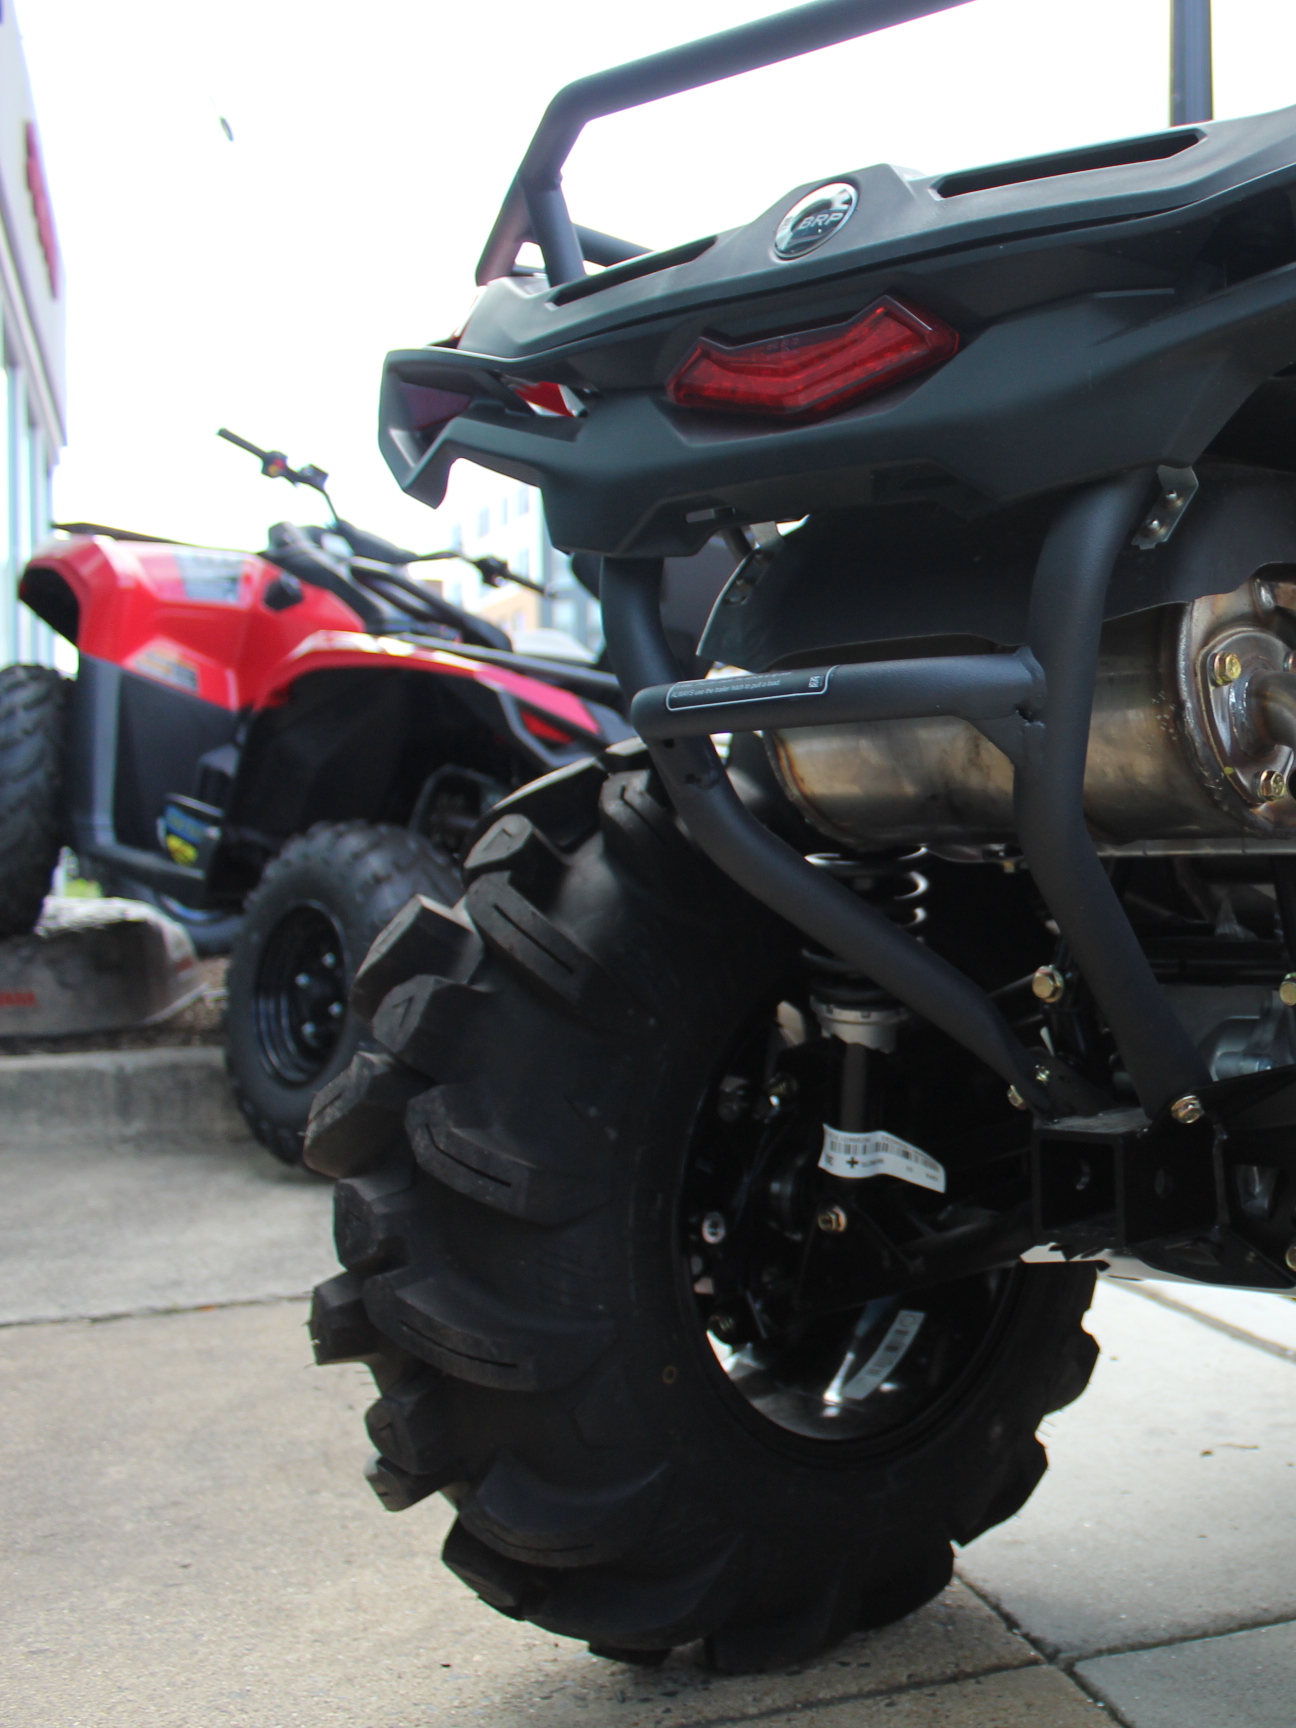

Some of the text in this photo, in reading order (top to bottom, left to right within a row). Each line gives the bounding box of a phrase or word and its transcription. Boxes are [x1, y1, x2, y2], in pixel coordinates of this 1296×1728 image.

[800, 212, 844, 229] BRP
[671, 689, 694, 698] ALWAYS
[714, 685, 730, 693] trailer
[750, 681, 762, 690] pull
